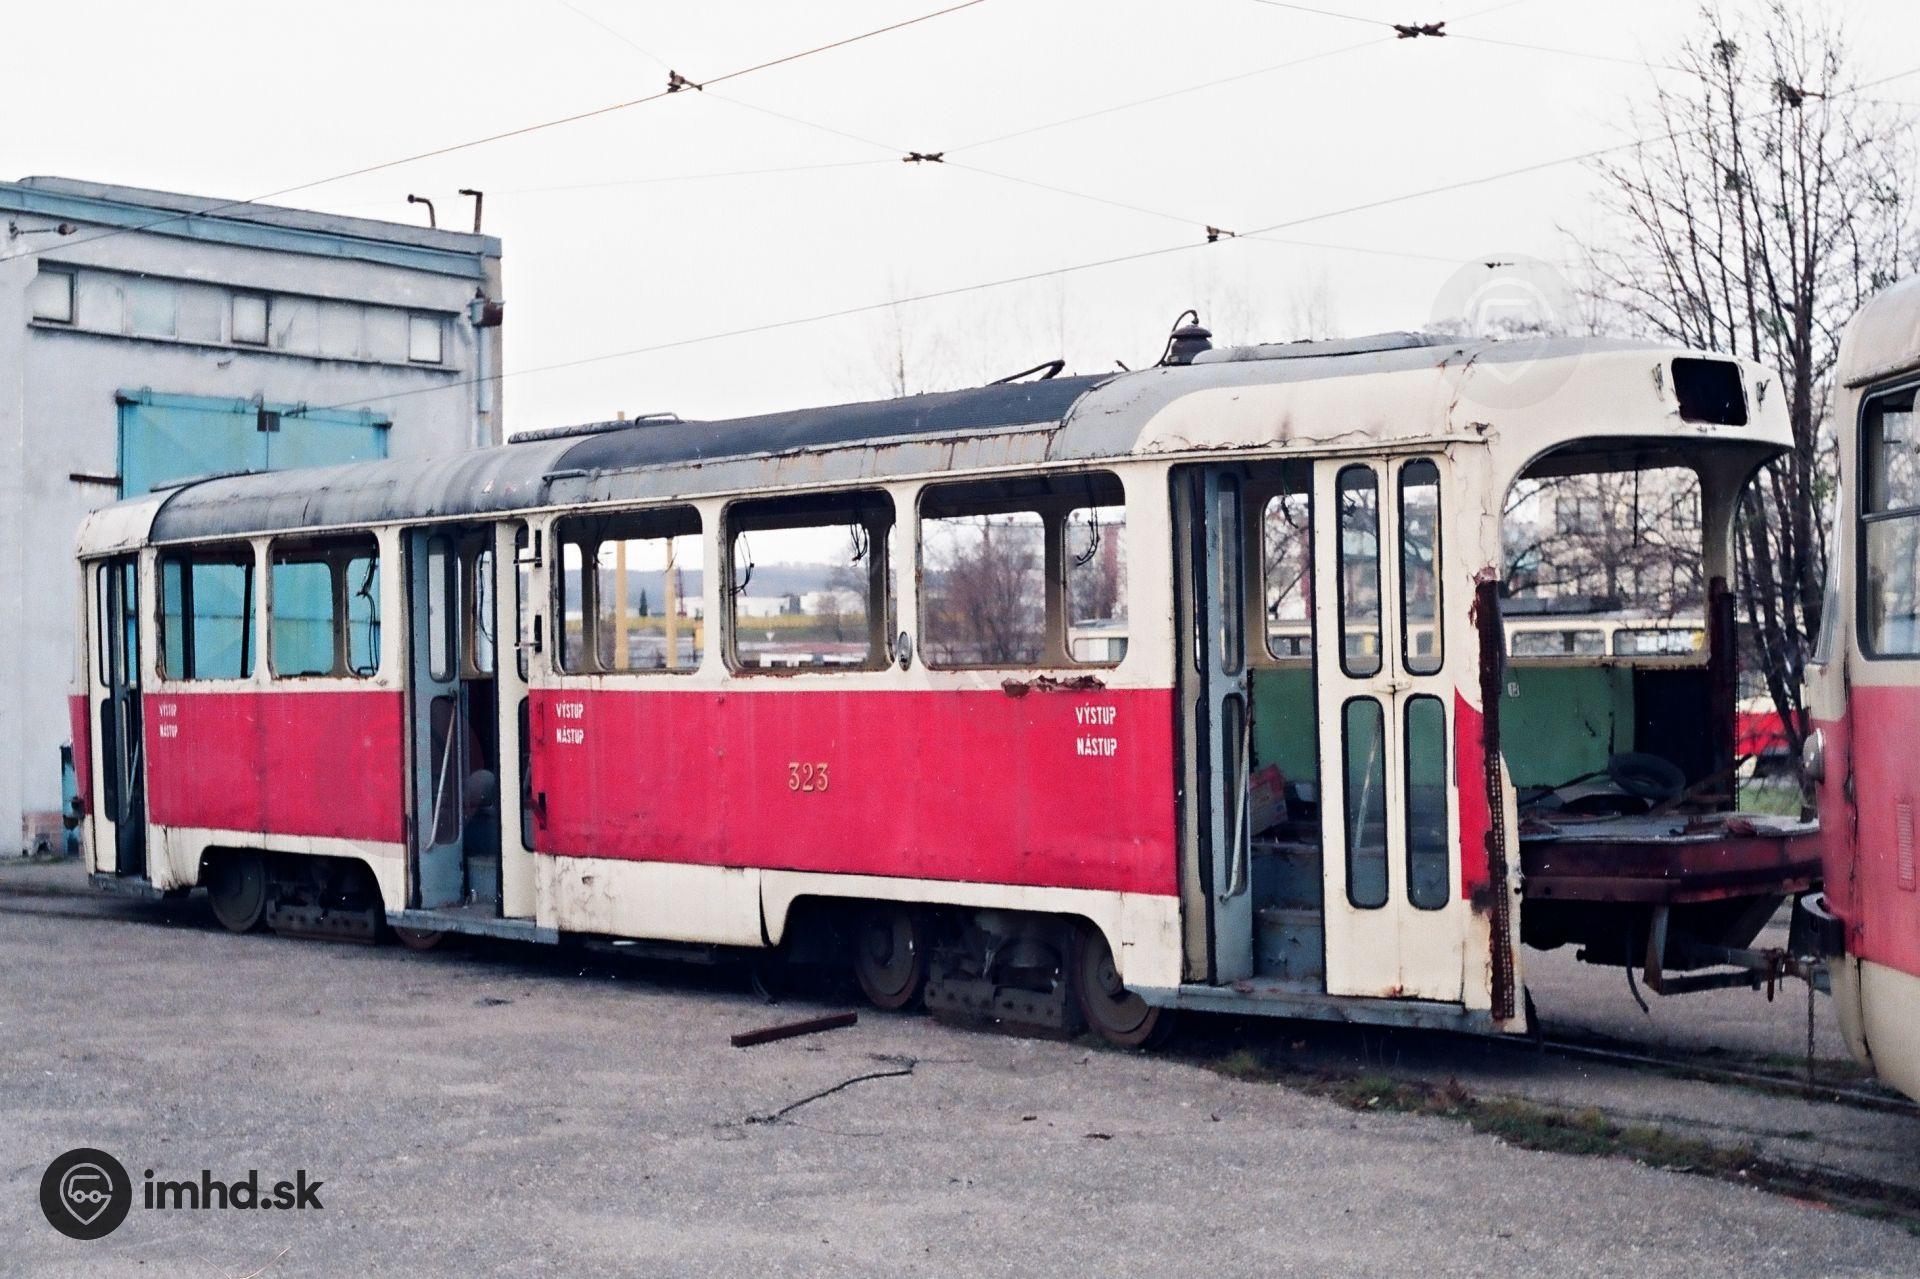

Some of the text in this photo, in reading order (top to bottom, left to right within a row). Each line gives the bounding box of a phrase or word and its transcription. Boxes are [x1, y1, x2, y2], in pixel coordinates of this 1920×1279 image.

[555, 700, 584, 719] VÝSTUP
[1075, 702, 1117, 725] VÝSTUP
[556, 725, 585, 744] NÁSTUP
[1076, 733, 1118, 757] NÁSTUP
[788, 761, 828, 792] 323
